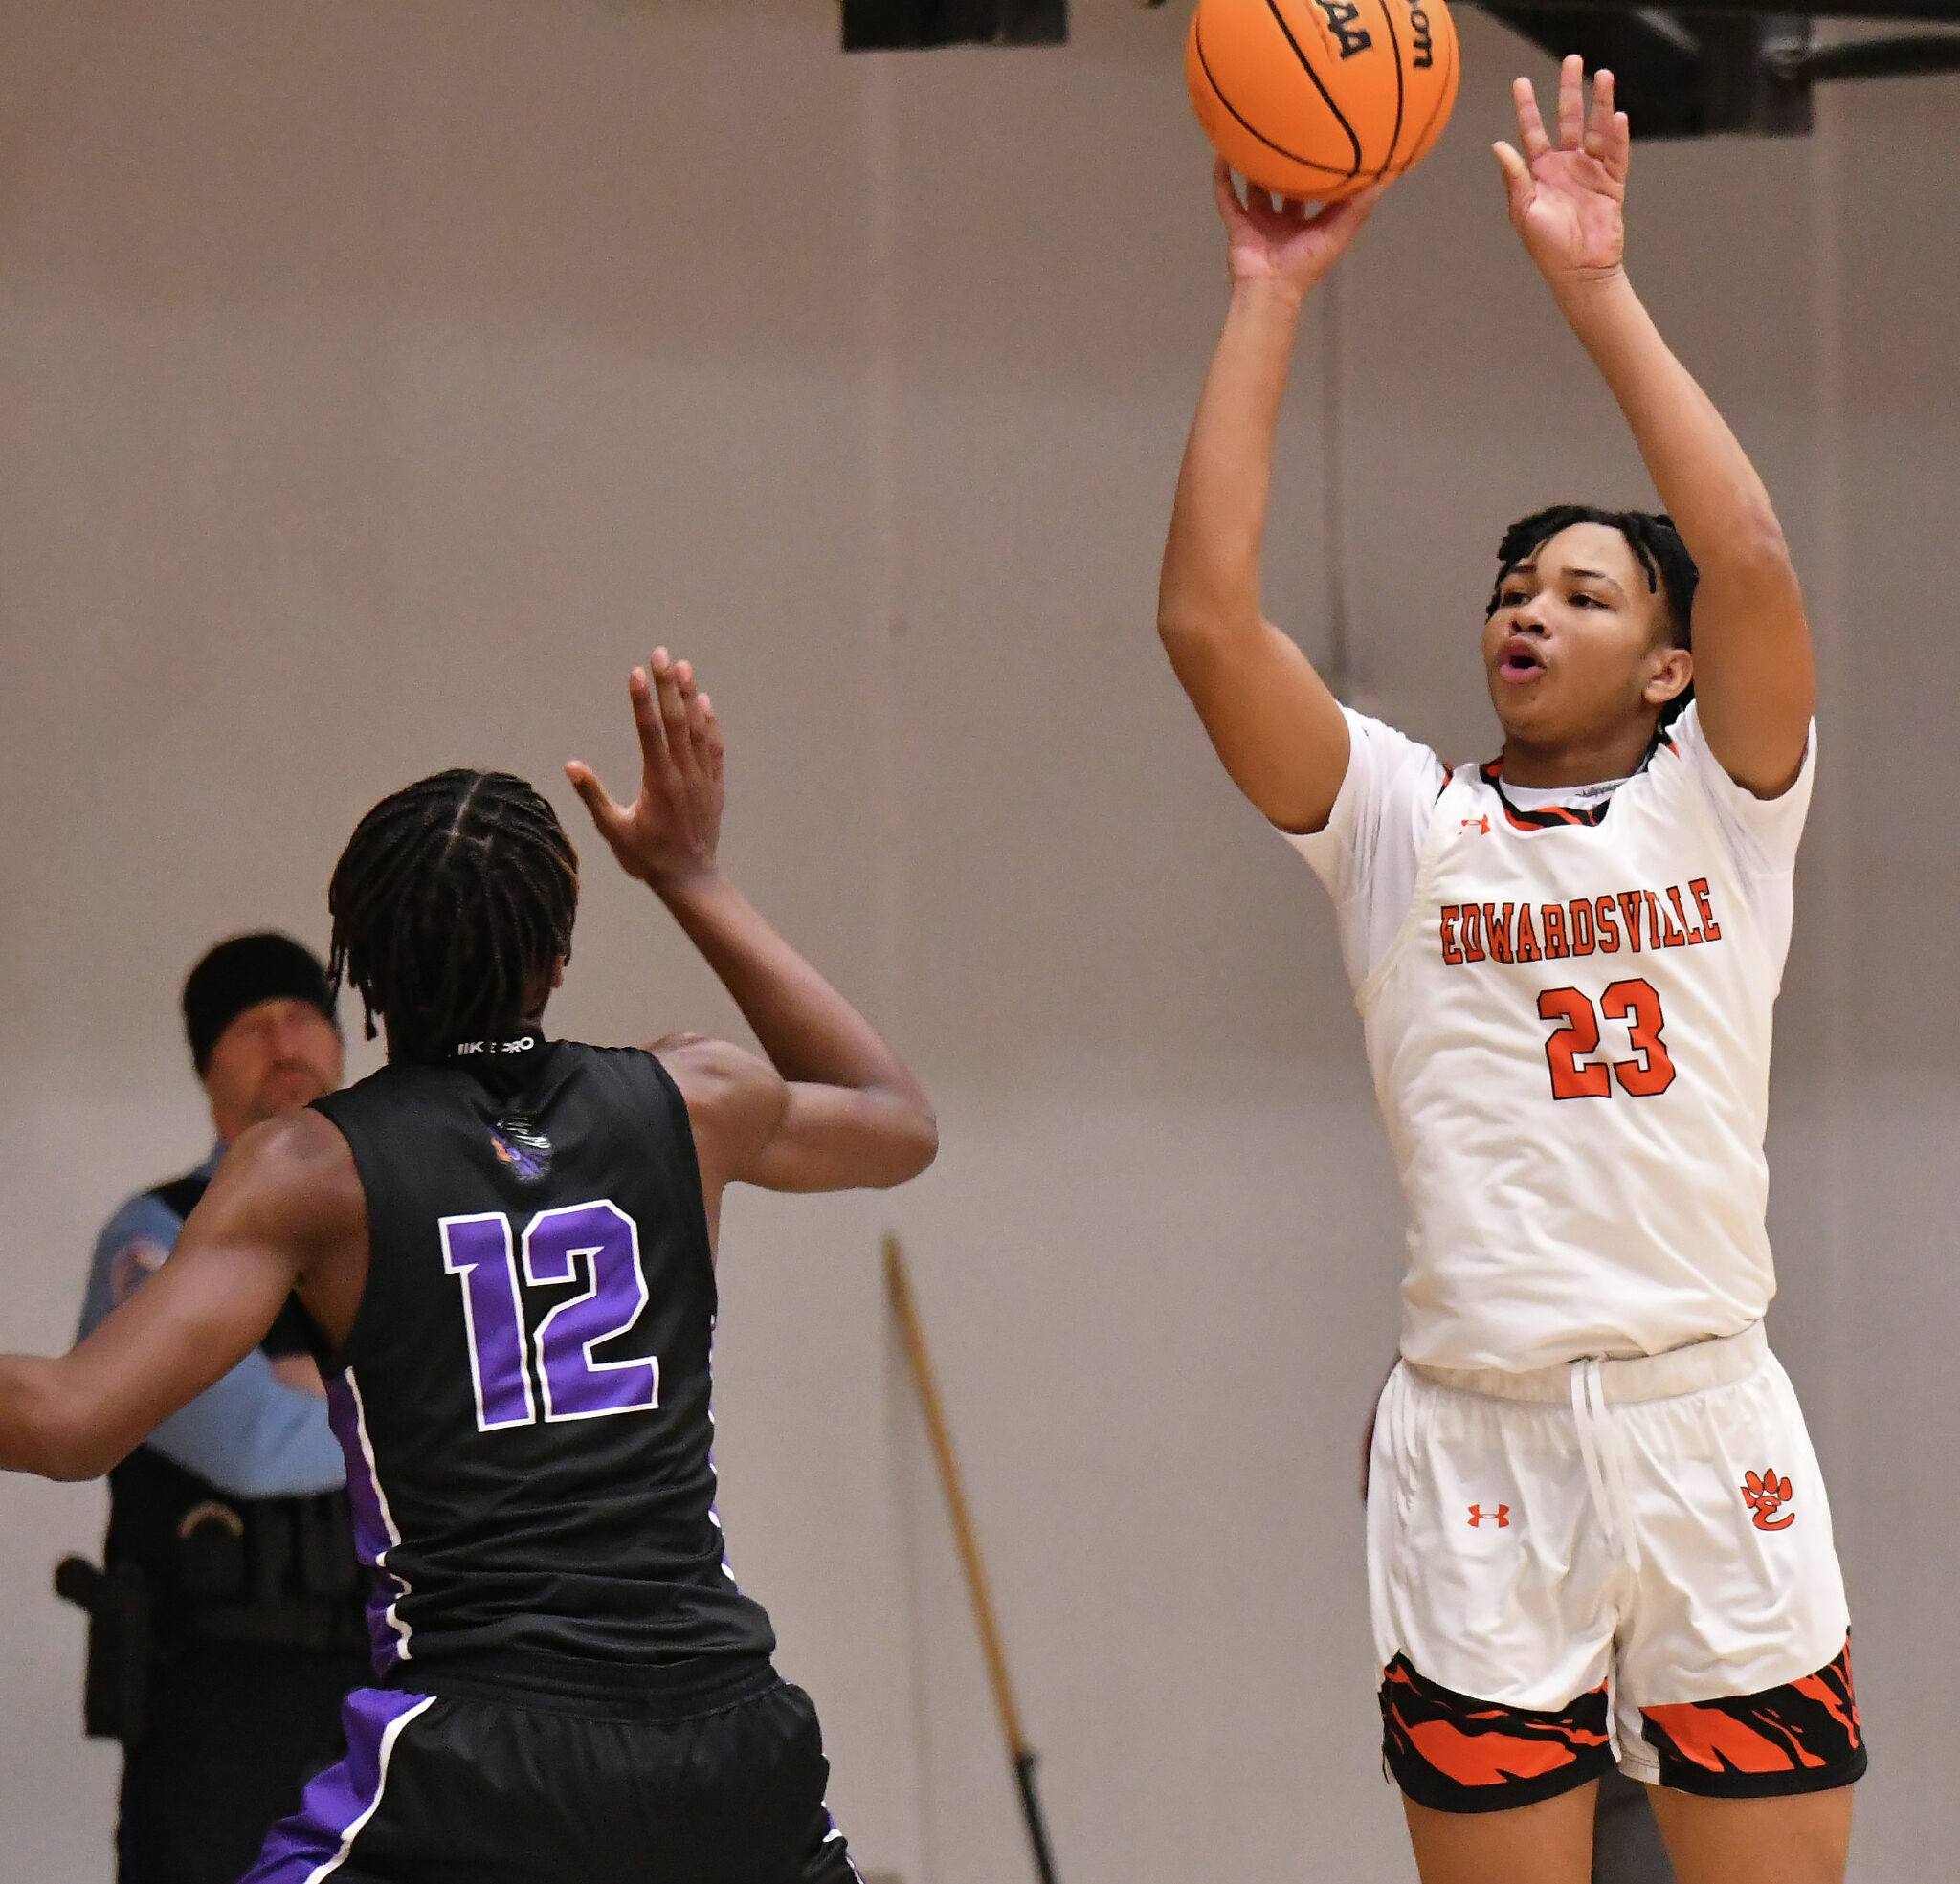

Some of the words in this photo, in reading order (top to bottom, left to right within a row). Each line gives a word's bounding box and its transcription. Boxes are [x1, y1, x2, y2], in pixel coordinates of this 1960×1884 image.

[1409, 0, 1433, 70] on
[1440, 876, 1722, 965] EDWARDSVILLE
[1536, 977, 1676, 1100] 23
[437, 1198, 660, 1432] 12
